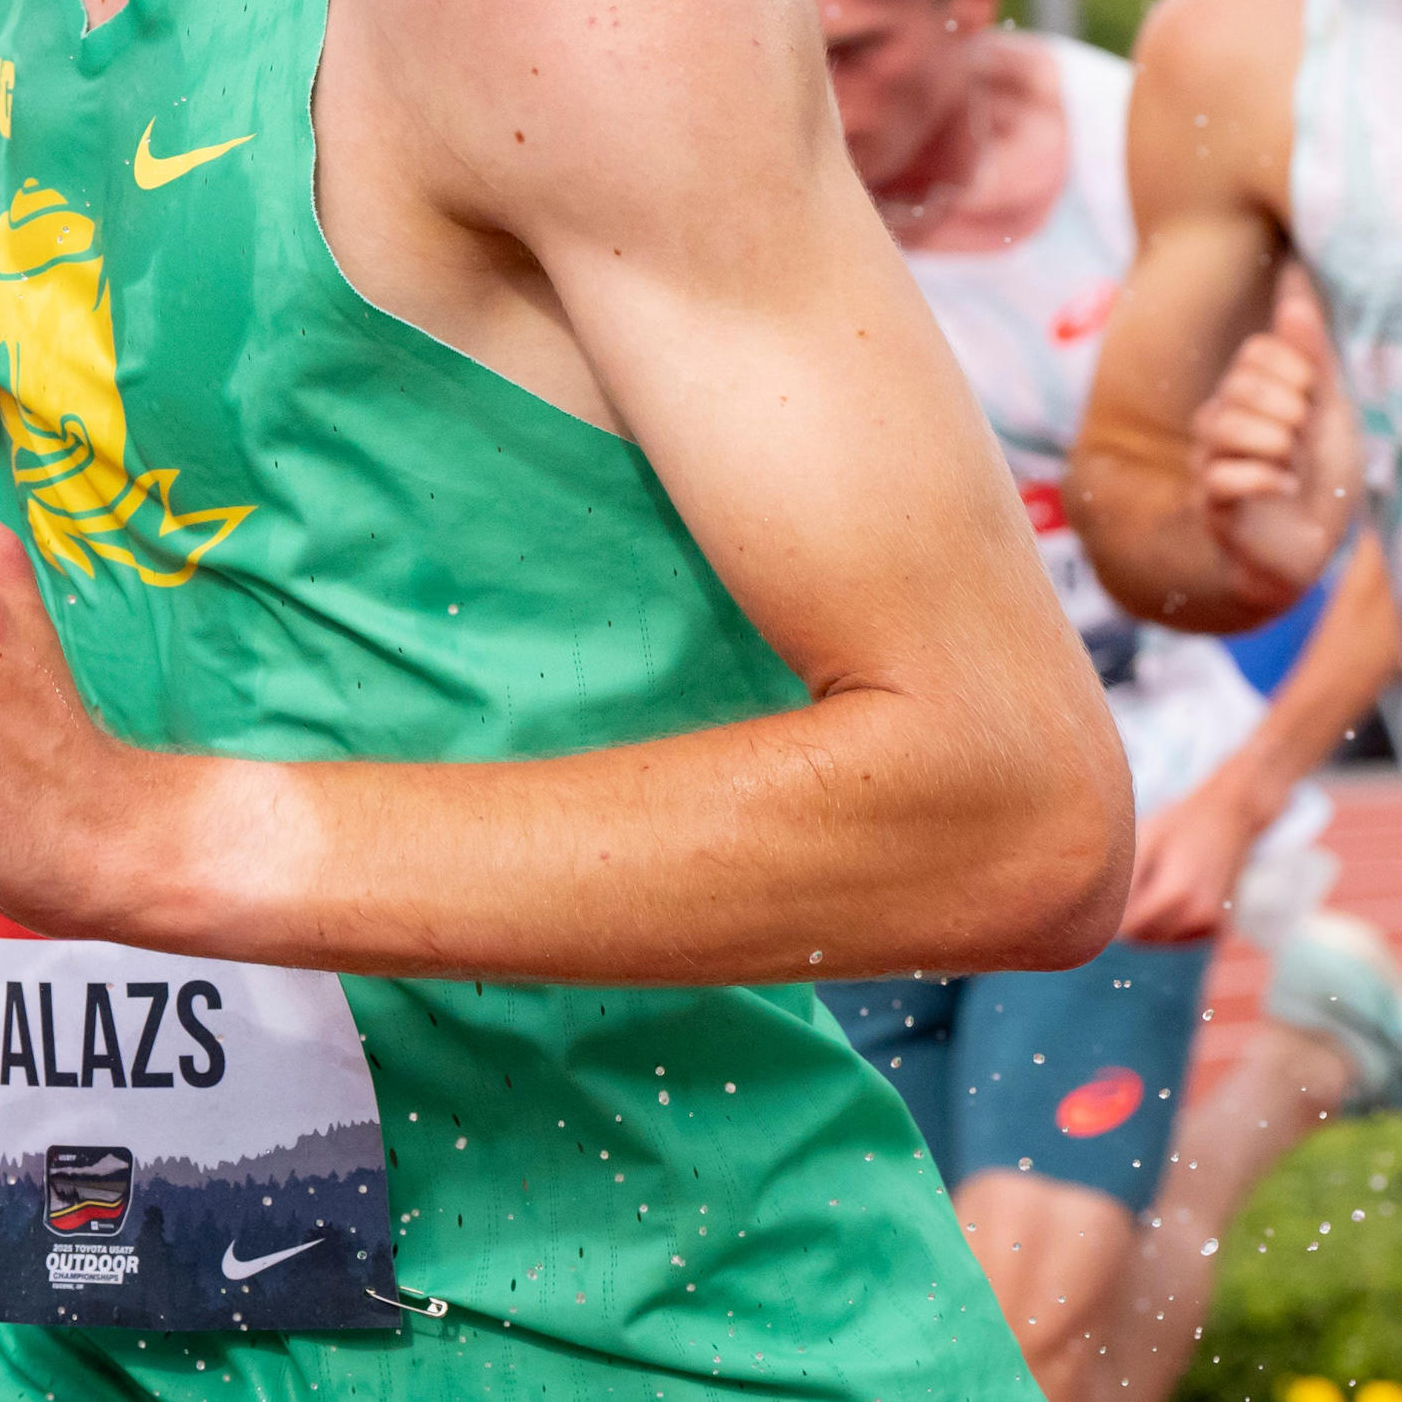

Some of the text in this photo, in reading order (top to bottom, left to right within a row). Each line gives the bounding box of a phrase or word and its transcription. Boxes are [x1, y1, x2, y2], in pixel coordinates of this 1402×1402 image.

[75, 1245, 107, 1253] TOYOTA
[109, 1246, 134, 1254] USATF
[46, 1253, 139, 1273] OUTDOOR
[53, 1272, 119, 1282] CHAMPIONSHIPS
